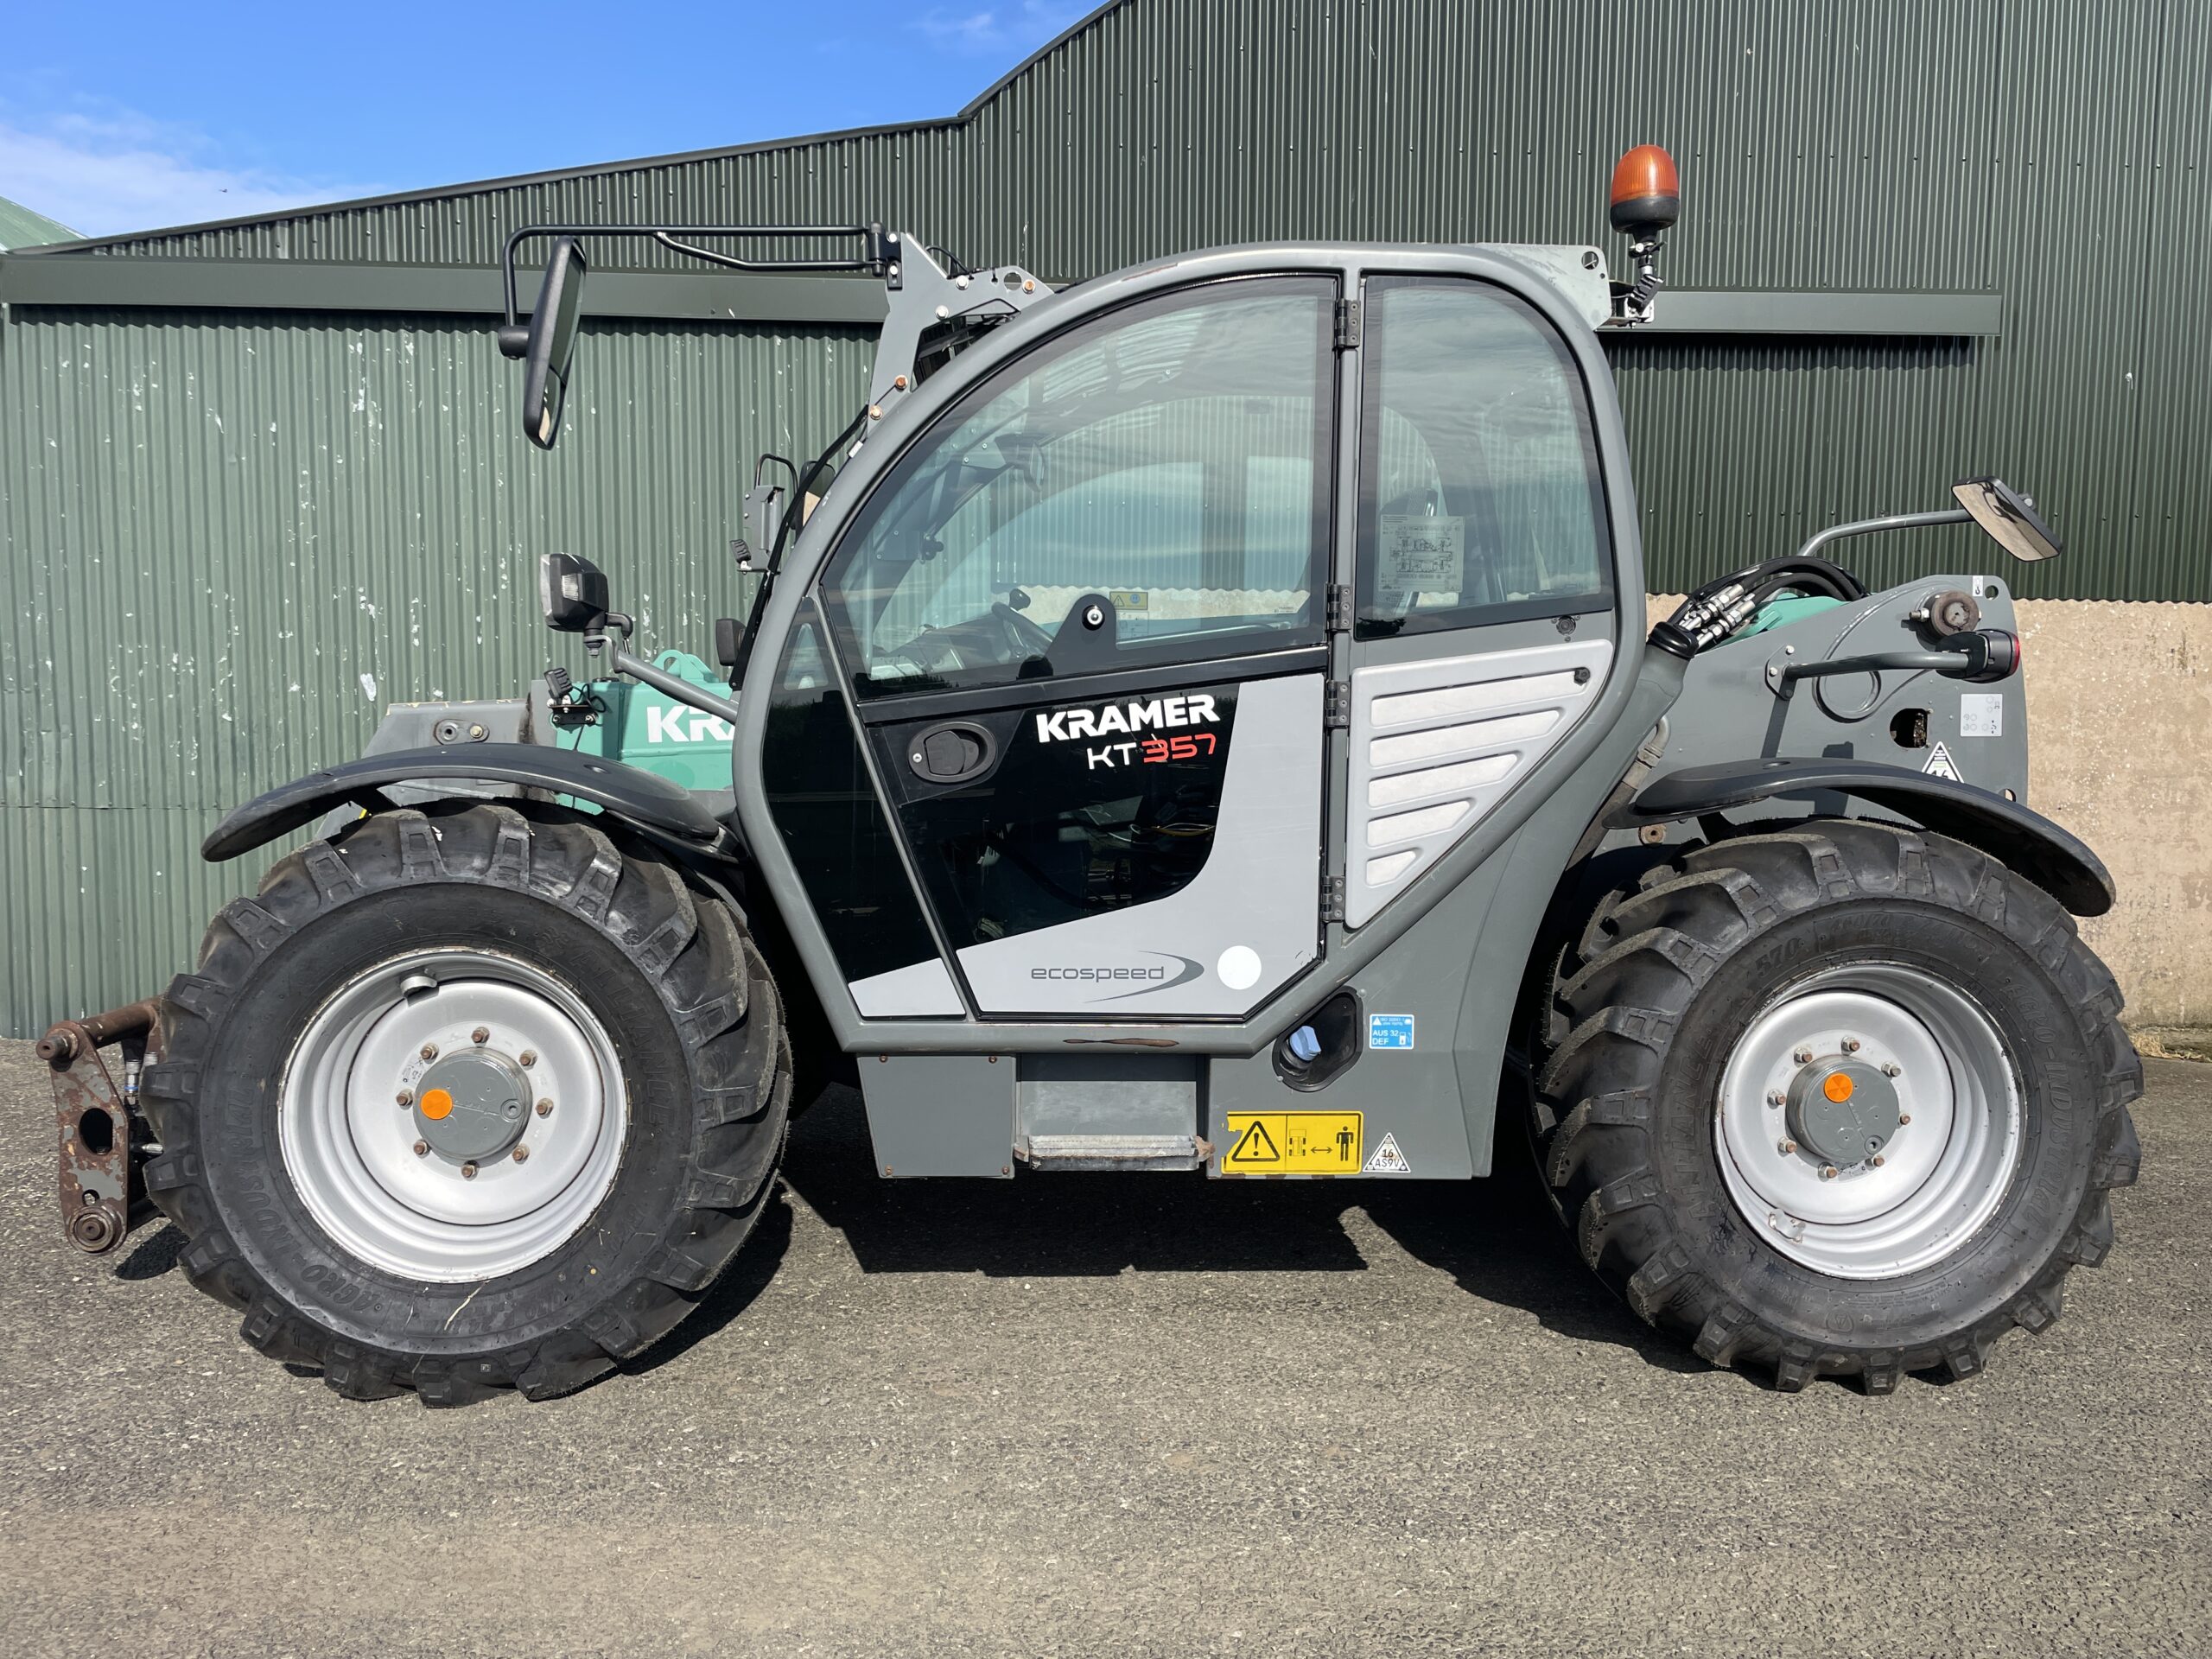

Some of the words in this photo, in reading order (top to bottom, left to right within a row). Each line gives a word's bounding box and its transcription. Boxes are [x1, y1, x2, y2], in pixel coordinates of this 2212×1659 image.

[1037, 695, 1220, 742] KRAMER
[1087, 734, 1217, 770] KT357
[1031, 965, 1165, 983] ecospeed
[569, 947, 671, 1127] ALLIANCE
[1677, 1029, 1715, 1222] ALLIANCE
[1382, 1149, 1394, 1158] 16
